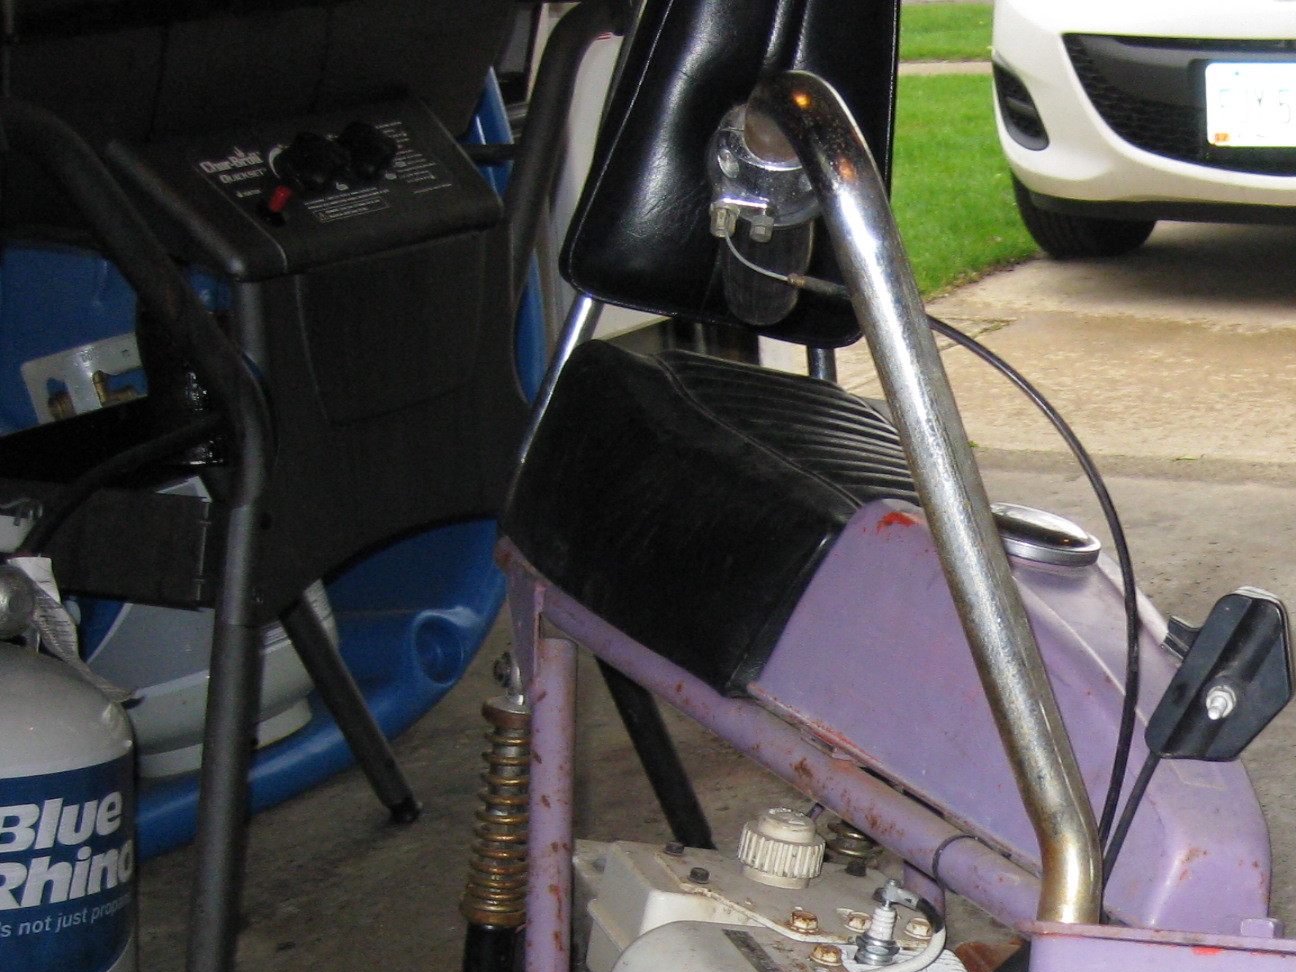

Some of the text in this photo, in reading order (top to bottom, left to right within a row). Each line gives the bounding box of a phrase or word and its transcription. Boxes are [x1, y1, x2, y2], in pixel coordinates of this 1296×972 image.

[0, 792, 123, 853] Blue
[0, 840, 134, 910] Rhino
[18, 914, 52, 935] not
[54, 907, 89, 933] just
